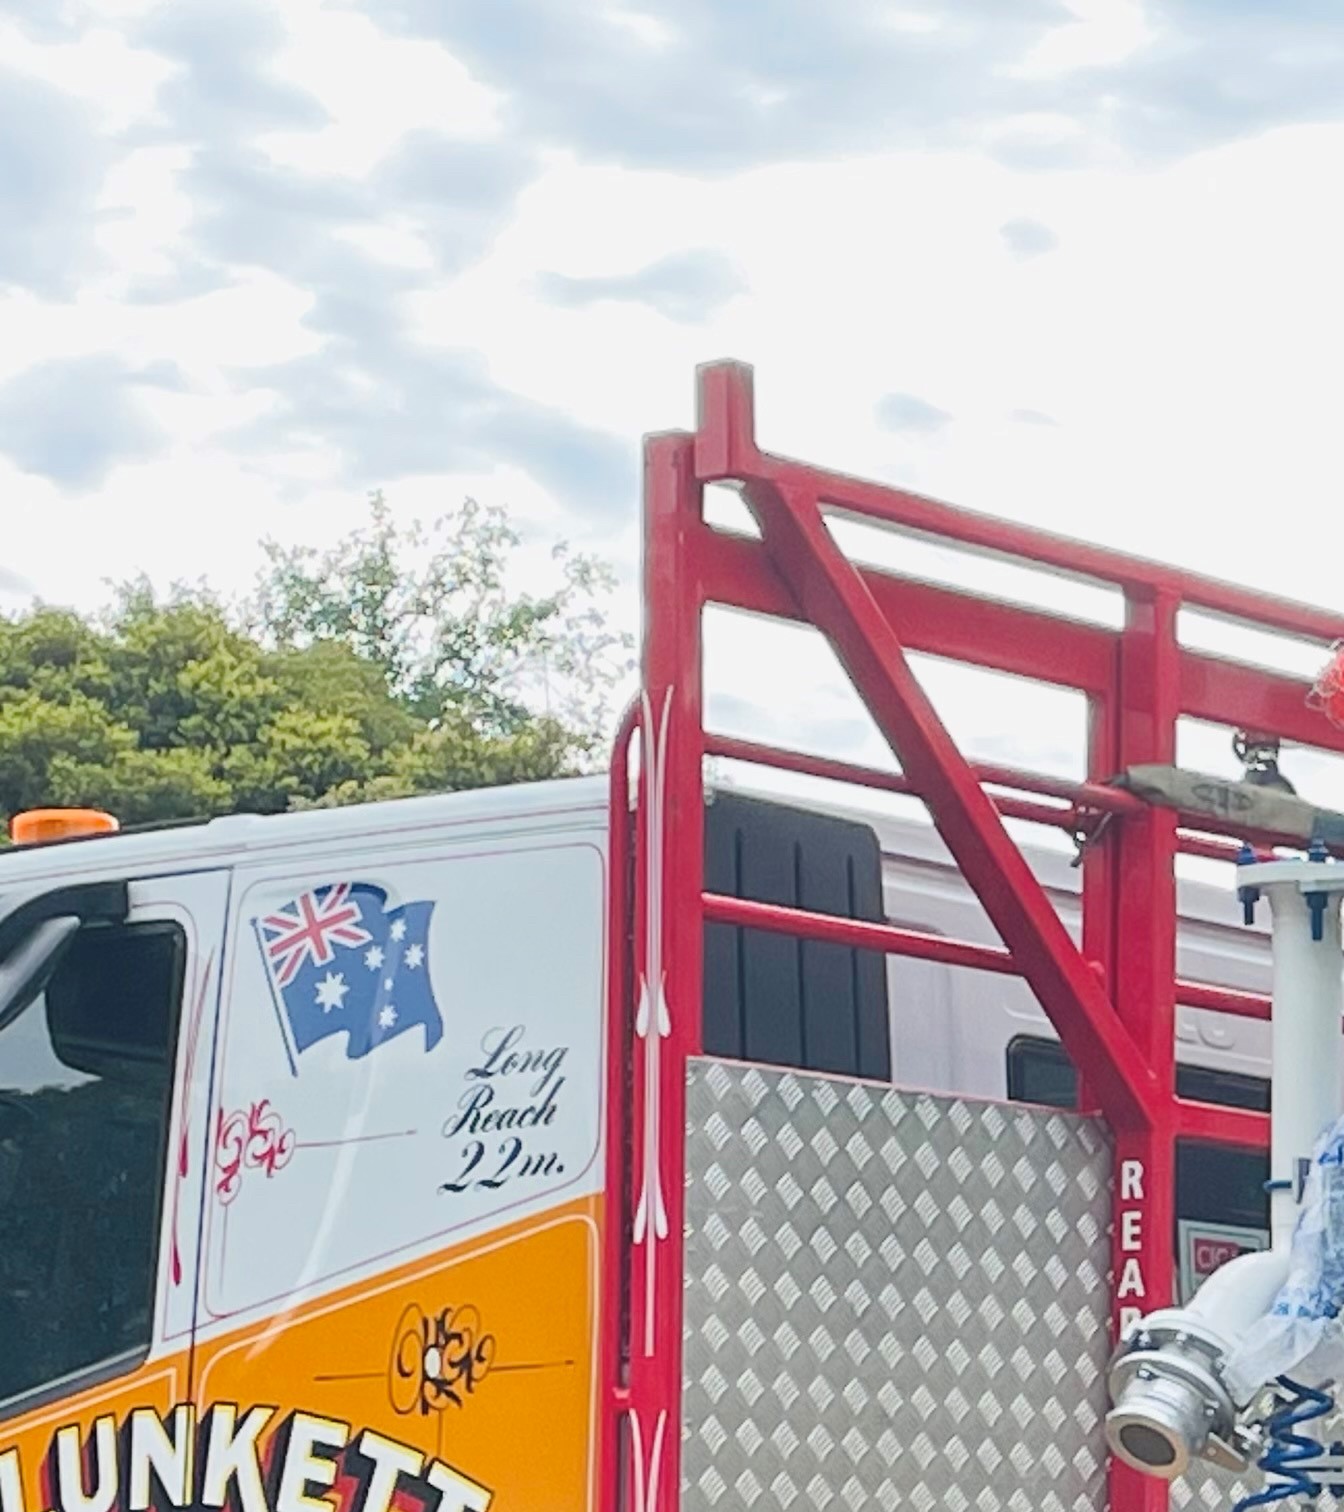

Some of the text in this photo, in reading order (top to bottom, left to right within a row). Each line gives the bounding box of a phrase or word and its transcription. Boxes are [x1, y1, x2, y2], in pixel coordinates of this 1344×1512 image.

[464, 1024, 570, 1097] Long
[442, 1076, 566, 1138] Reach
[437, 1136, 565, 1193] 22m.
